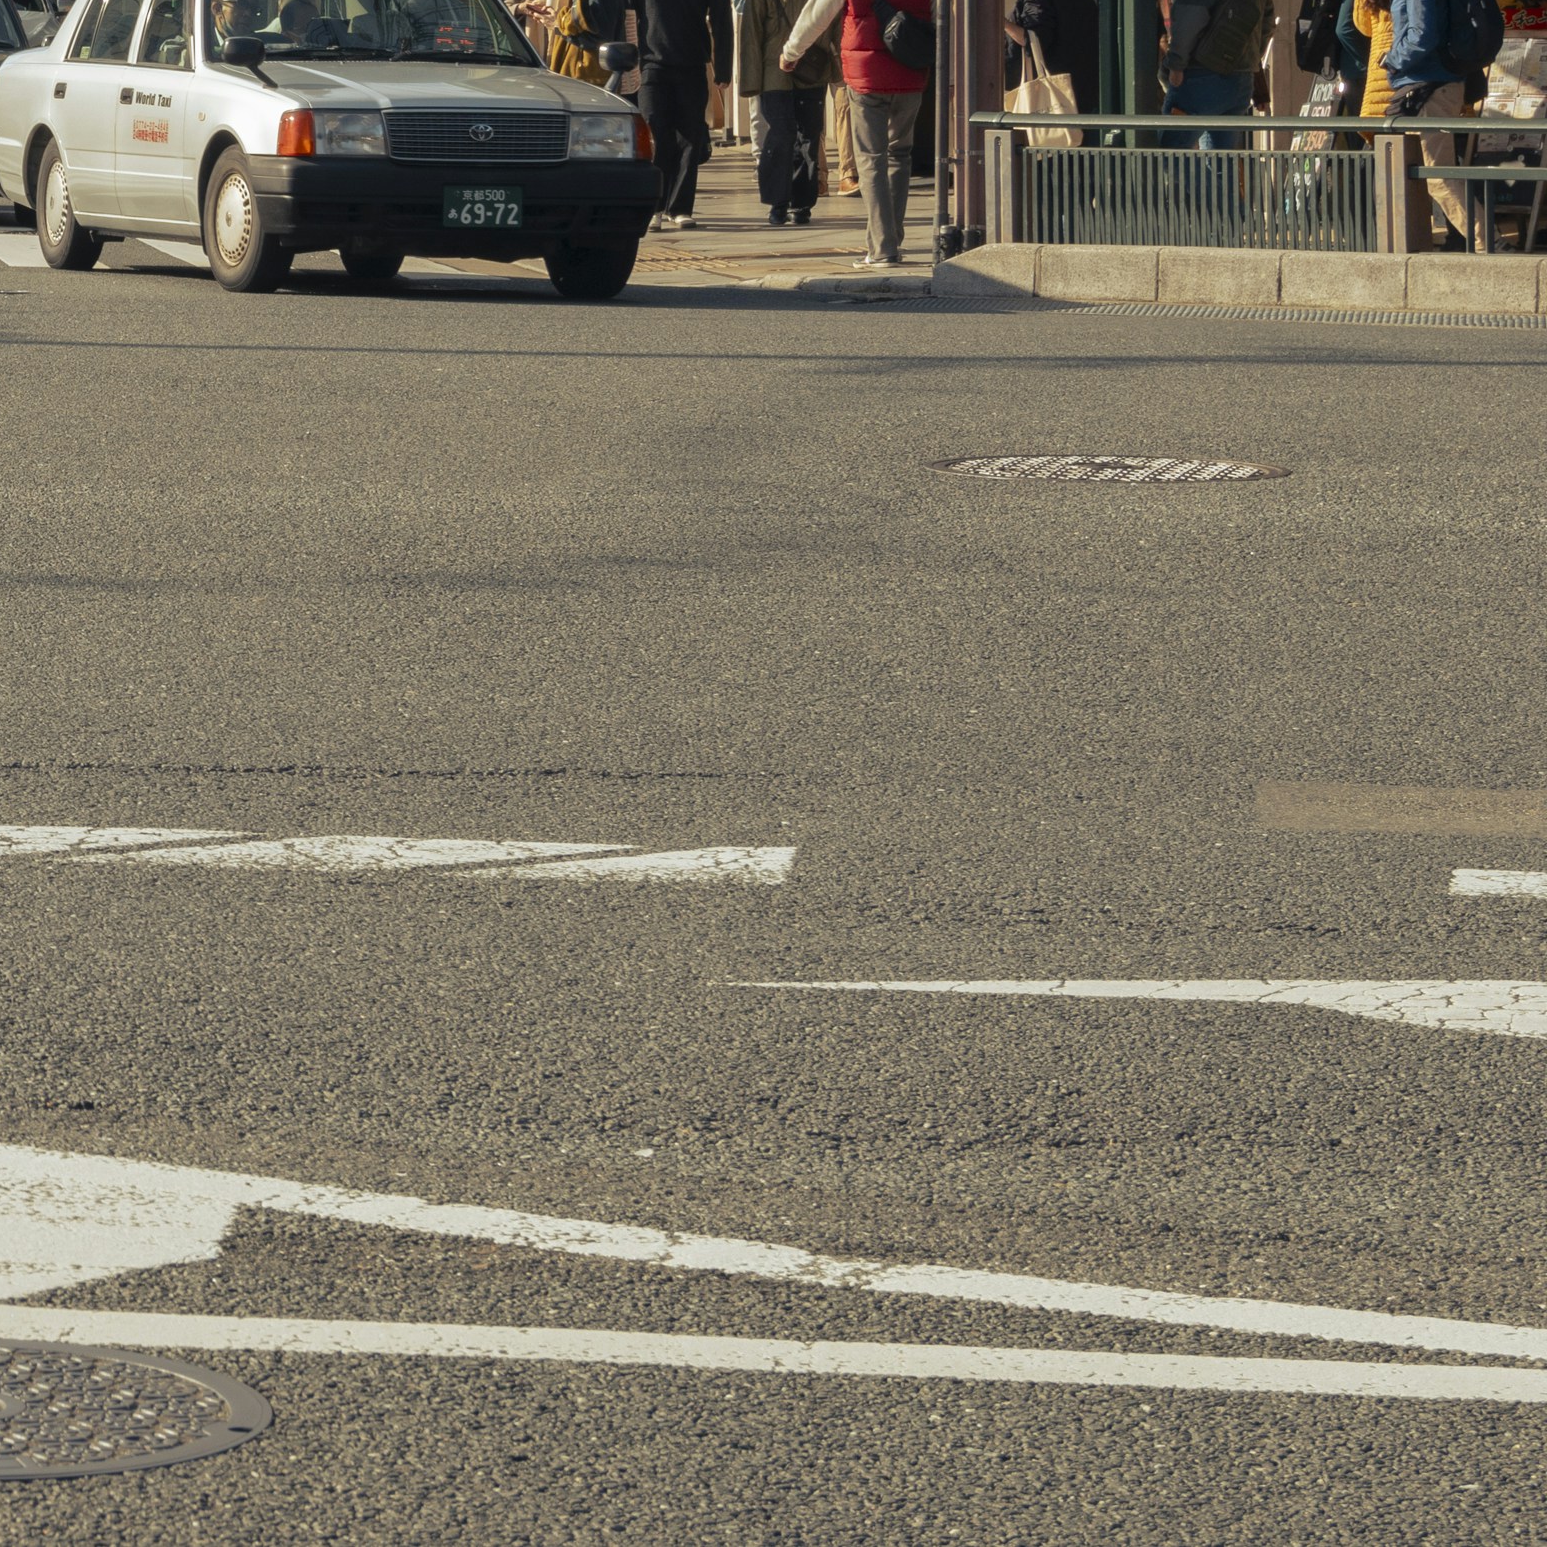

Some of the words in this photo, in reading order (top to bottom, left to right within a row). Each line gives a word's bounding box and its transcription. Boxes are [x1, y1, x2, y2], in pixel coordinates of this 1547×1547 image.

[135, 91, 156, 106] World
[157, 94, 172, 108] Taxi
[462, 189, 506, 201] 京都500
[448, 208, 458, 219] あ
[460, 203, 519, 225] 69-72
